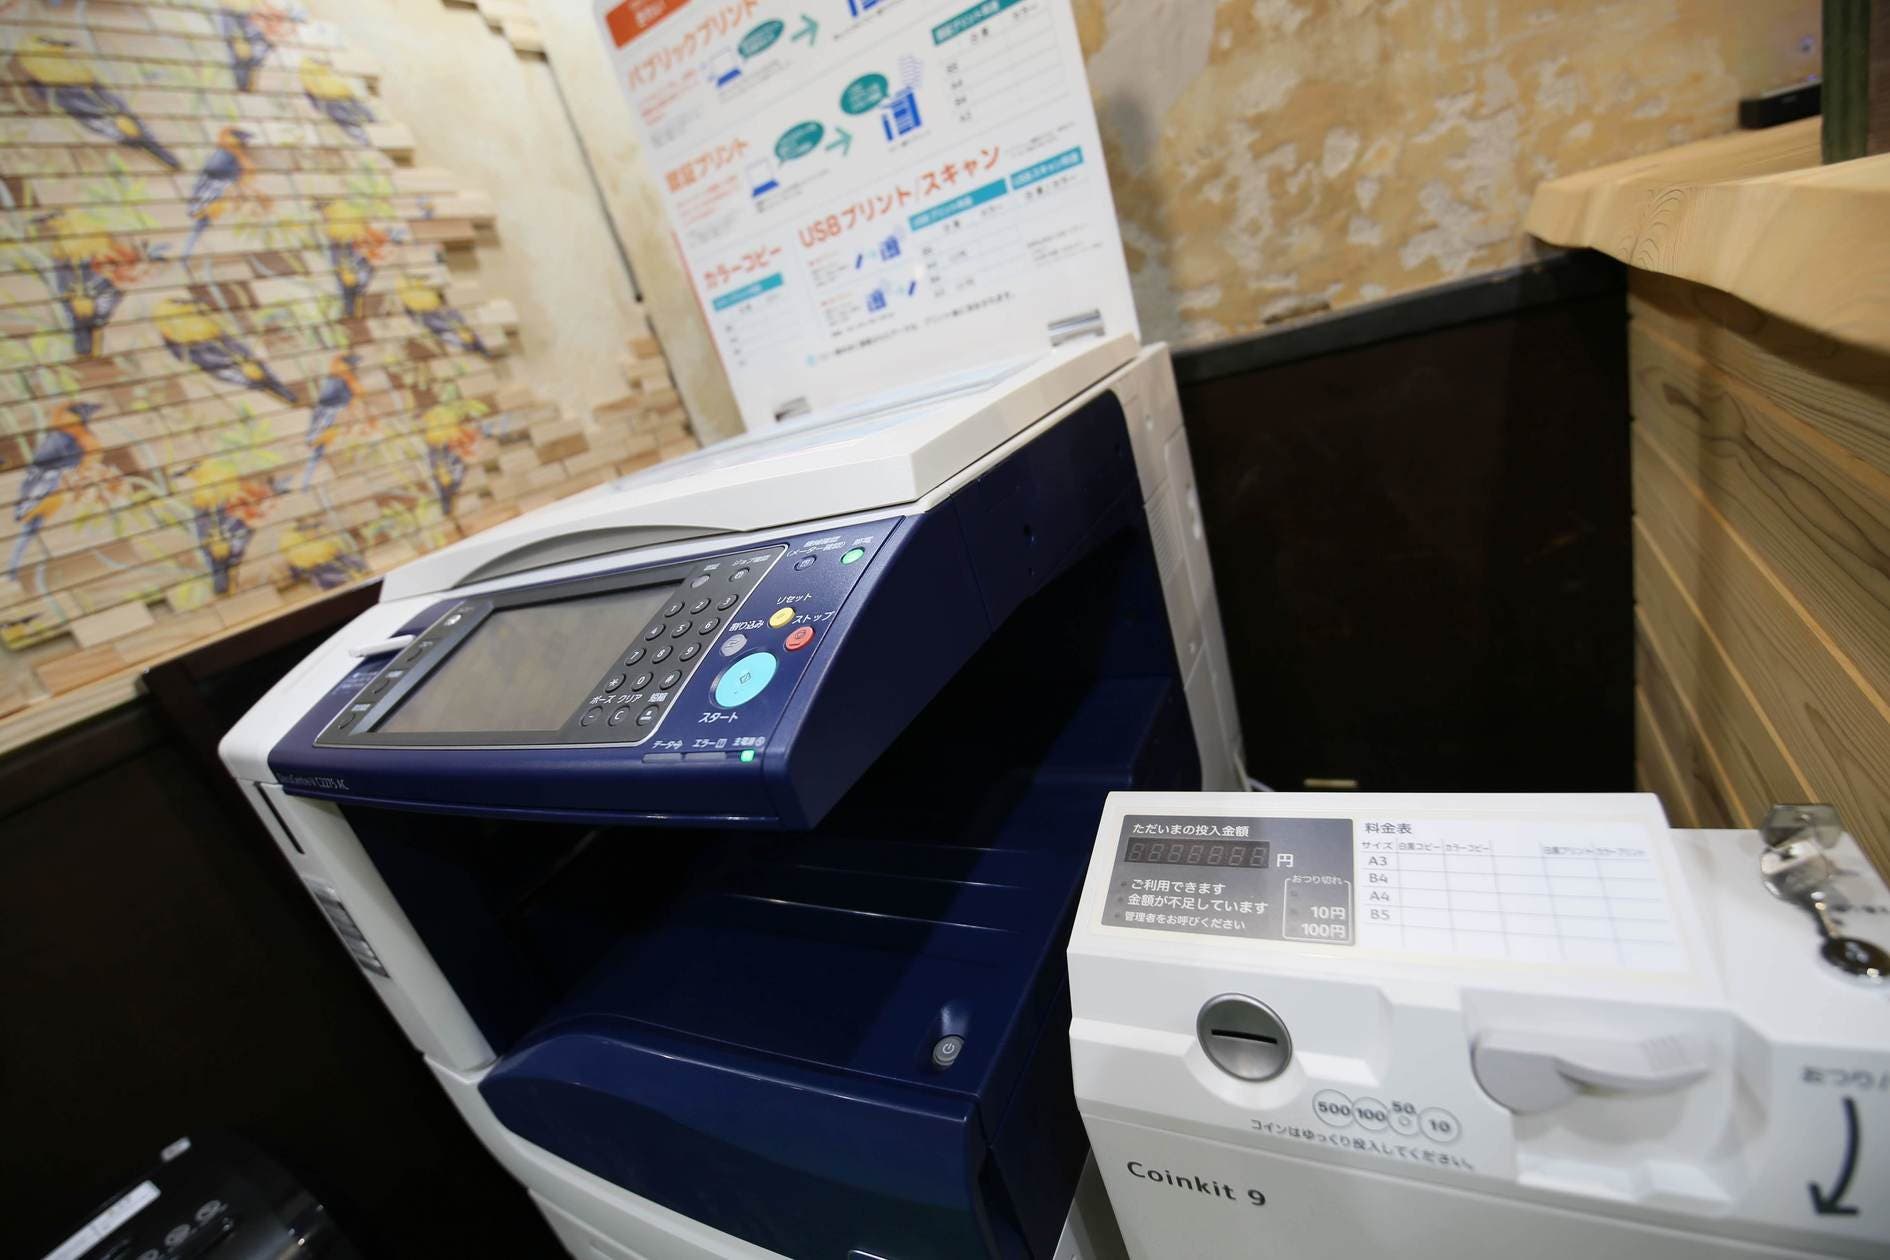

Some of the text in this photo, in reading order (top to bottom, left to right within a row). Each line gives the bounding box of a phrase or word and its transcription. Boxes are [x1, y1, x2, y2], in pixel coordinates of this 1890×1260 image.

[777, 593, 812, 605] リセット
[792, 610, 836, 625] ストップ
[617, 694, 642, 703] クリア
[614, 710, 625, 720] C
[698, 711, 739, 724] スタート
[692, 738, 717, 748] エラー
[1132, 823, 1249, 838] ただいまの投入金額
[1365, 822, 1413, 834] 料金表
[1362, 841, 1394, 850] サイズ
[1276, 853, 1294, 868] 円
[1368, 856, 1388, 866] A3
[1291, 874, 1343, 885] おつり切れ
[1369, 873, 1389, 884] B4
[1131, 879, 1227, 895] ご利用できます
[1369, 891, 1390, 902] A4
[1127, 894, 1269, 915] 金額が不足しています
[1125, 910, 1246, 930] 管理者をお呼びください
[1311, 906, 1346, 920] 10円
[1370, 909, 1391, 921] B5
[1301, 923, 1346, 938] 100円
[1317, 1101, 1351, 1117] 500
[1391, 1100, 1416, 1115] 50
[1357, 1108, 1387, 1123] 100
[1430, 1118, 1451, 1134] 10
[1251, 1118, 1475, 1171] コインはゆっくり投入してください
[1127, 1160, 1268, 1207] Coinkit 9
